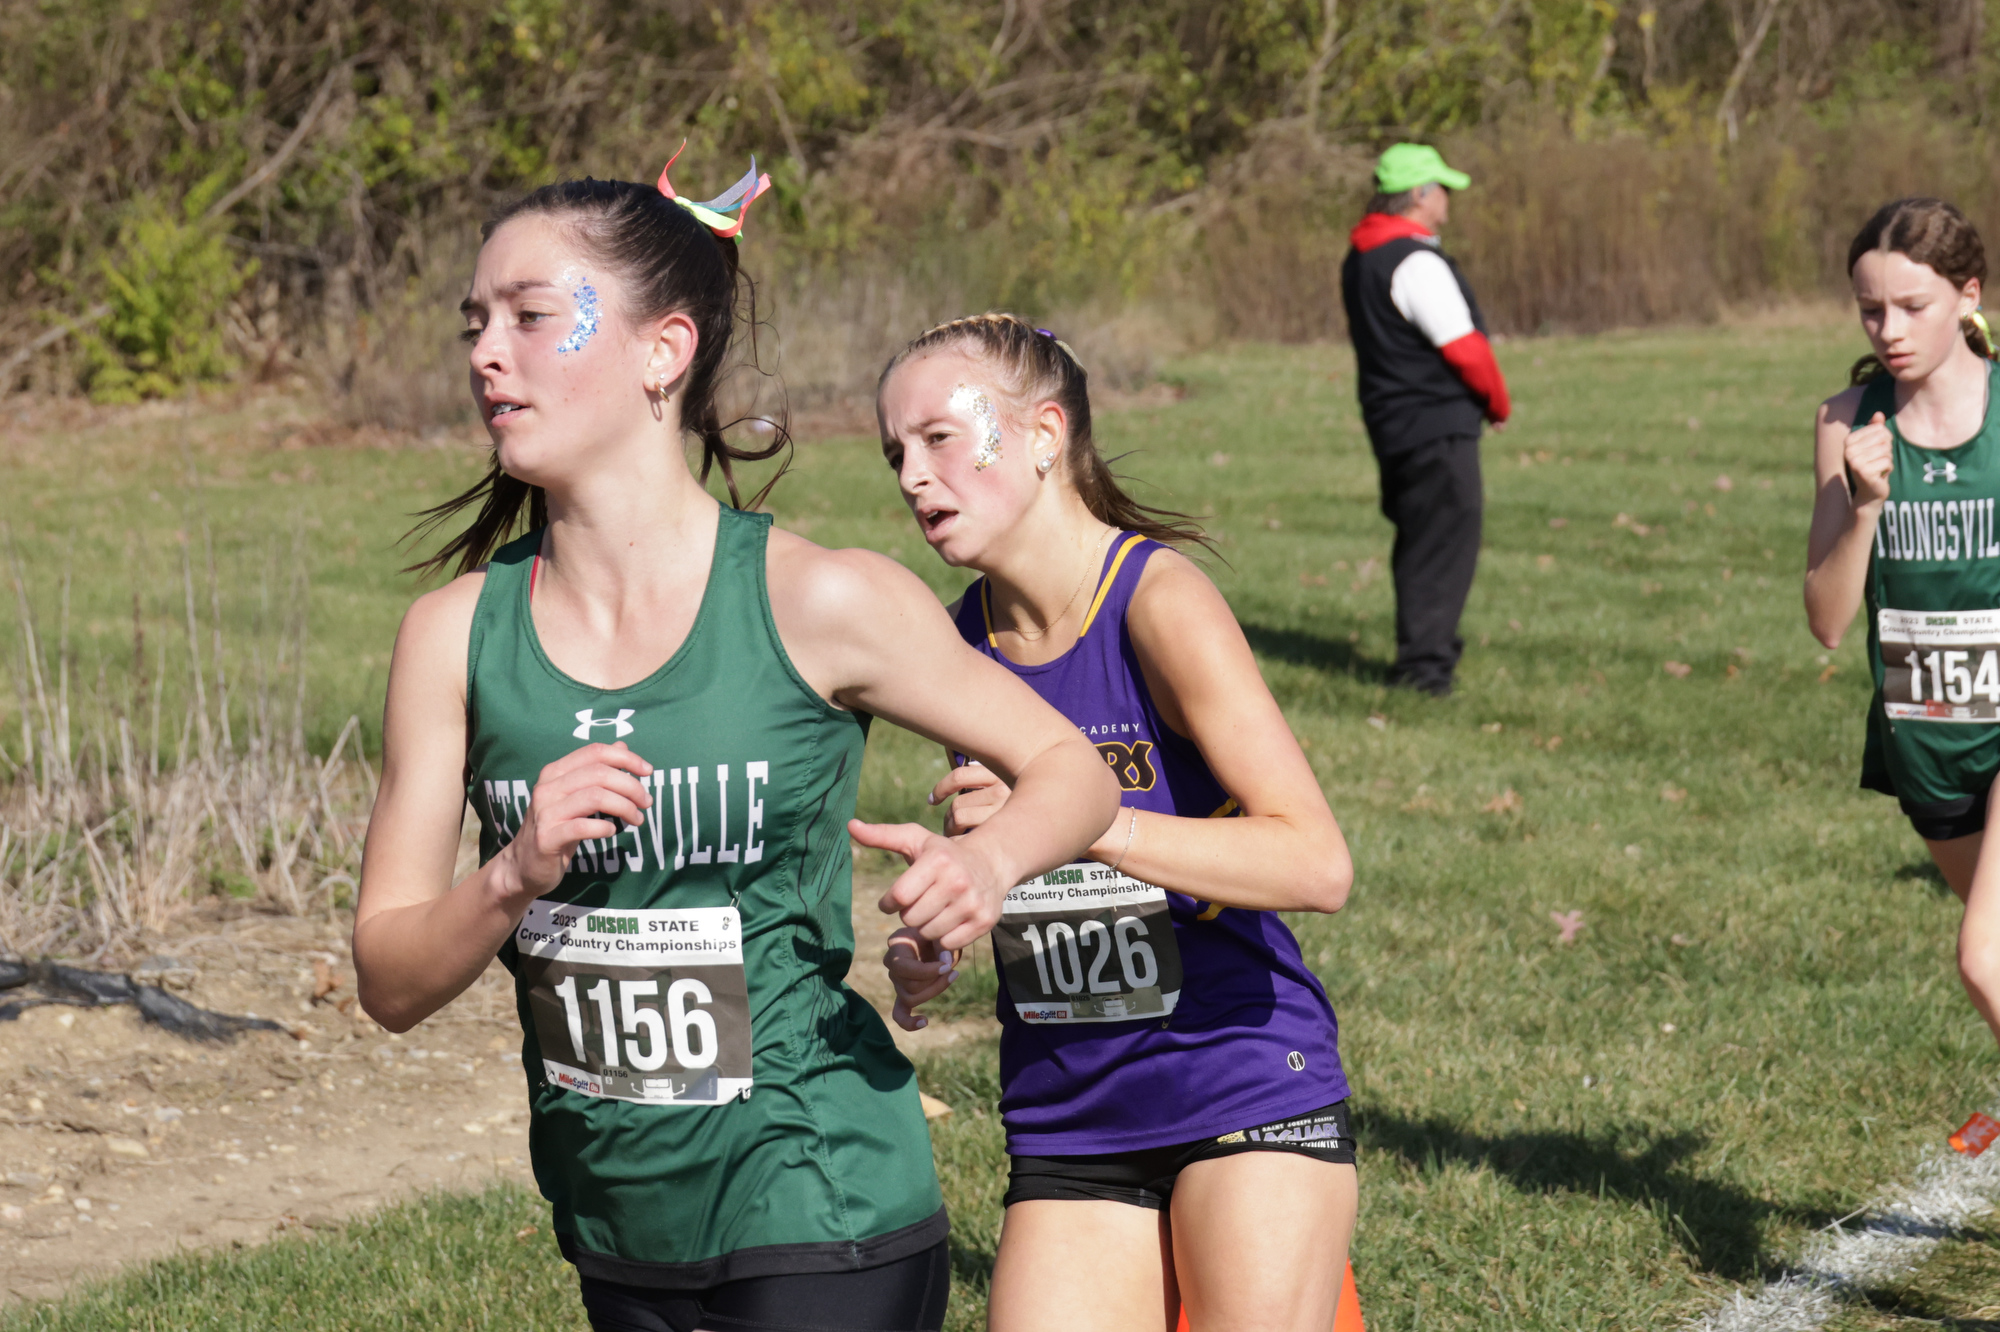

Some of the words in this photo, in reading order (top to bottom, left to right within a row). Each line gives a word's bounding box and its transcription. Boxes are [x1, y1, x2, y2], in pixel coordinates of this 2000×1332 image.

[1876, 498, 2000, 561] RONGSVIL
[1904, 650, 2000, 703] 1154
[1079, 723, 1140, 735] CADEMY
[1043, 869, 1084, 886] OHSAA
[1020, 890, 1064, 901] Country
[551, 913, 578, 928] 2023
[586, 915, 640, 934] OHSAA
[648, 920, 700, 932] STATE
[520, 928, 555, 943] Cross
[560, 934, 611, 952] Country
[615, 938, 737, 953] Championships
[1021, 915, 1159, 995] 1026
[554, 975, 718, 1072] 1156
[1023, 1010, 1057, 1021] MileSplit
[559, 1072, 589, 1090] MileSplit
[603, 1069, 628, 1078] 01156
[1262, 1123, 1284, 1132] SAINT
[1287, 1118, 1312, 1128] JOSEPH
